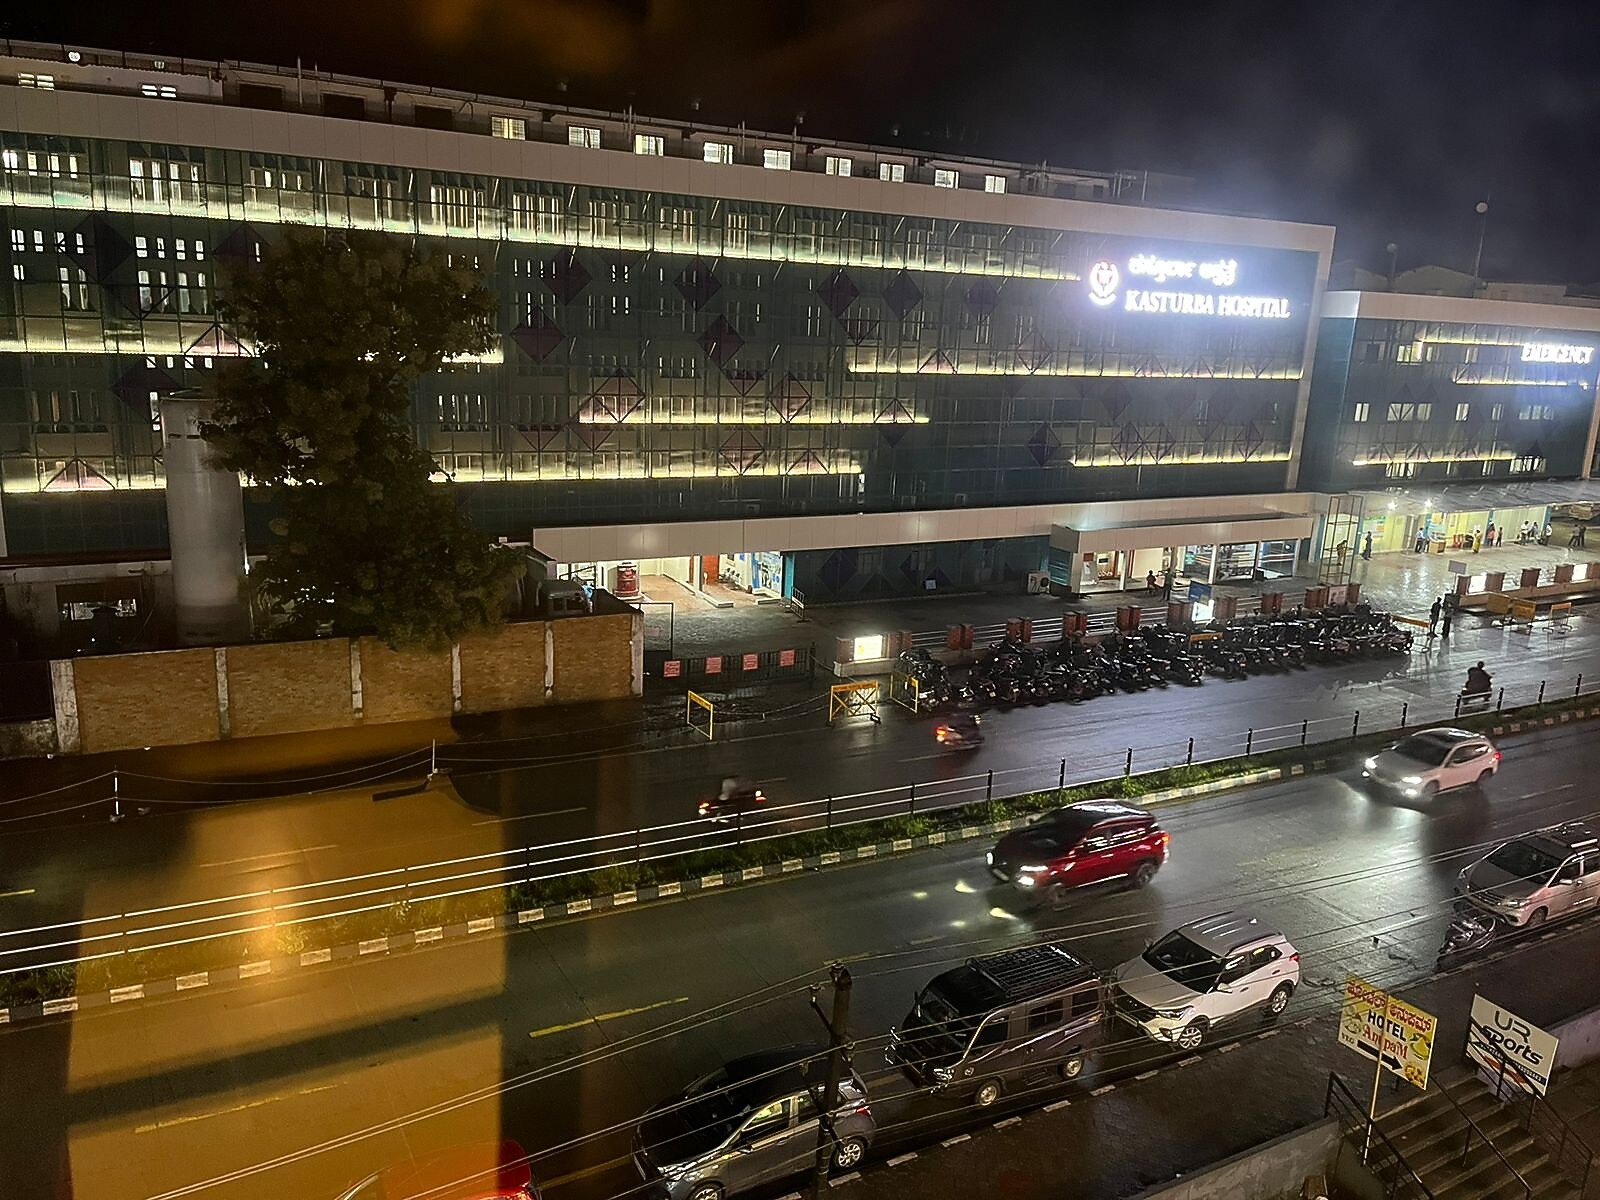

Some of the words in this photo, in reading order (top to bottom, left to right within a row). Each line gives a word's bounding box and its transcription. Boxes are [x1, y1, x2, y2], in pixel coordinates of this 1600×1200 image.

[1124, 289, 1215, 315] KASTURBA
[1217, 295, 1291, 319] HOSPITAL
[1520, 342, 1595, 364] EMERGENCY
[1367, 1008, 1408, 1043] HOTEL
[1494, 1010, 1532, 1044] UR
